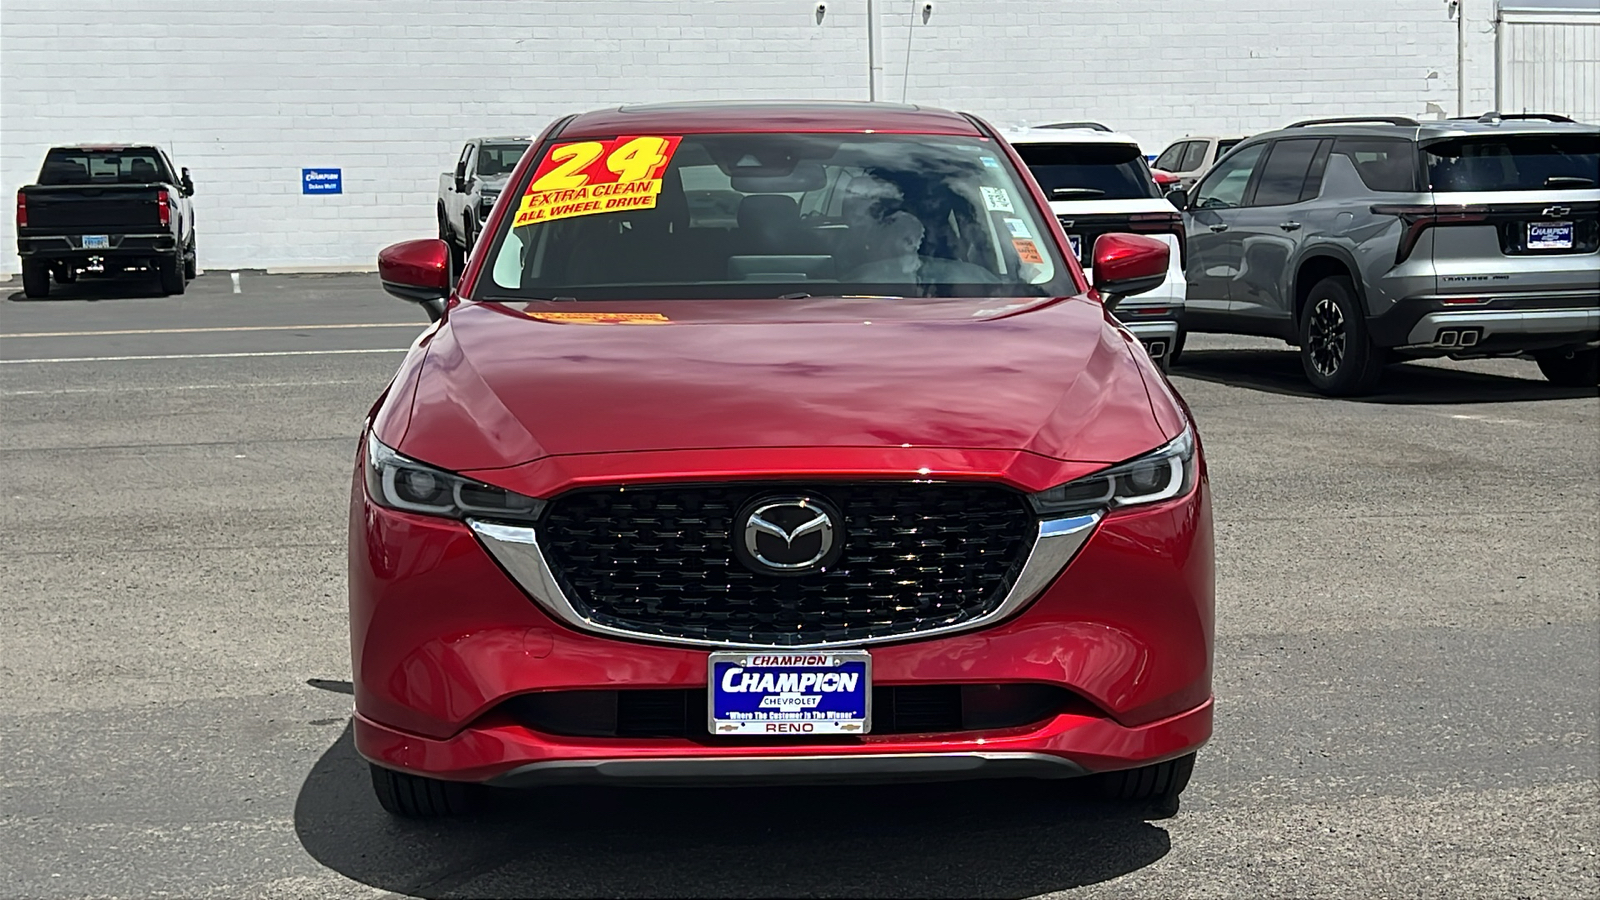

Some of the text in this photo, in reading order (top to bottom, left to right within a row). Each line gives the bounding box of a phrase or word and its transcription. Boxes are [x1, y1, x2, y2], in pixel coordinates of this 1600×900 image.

[531, 136, 670, 193] 24
[528, 181, 654, 208] EXTRA CLEAN
[517, 196, 653, 223] ALL WHEEL DRIVE
[1531, 227, 1569, 235] CHAMPION
[752, 656, 828, 666] CHAMPION
[721, 668, 859, 692] CHAMPION
[763, 697, 817, 705] CHEVROLET
[754, 711, 768, 720] The
[769, 711, 803, 720] Customer
[812, 711, 826, 720] The
[765, 723, 814, 732] RENO
